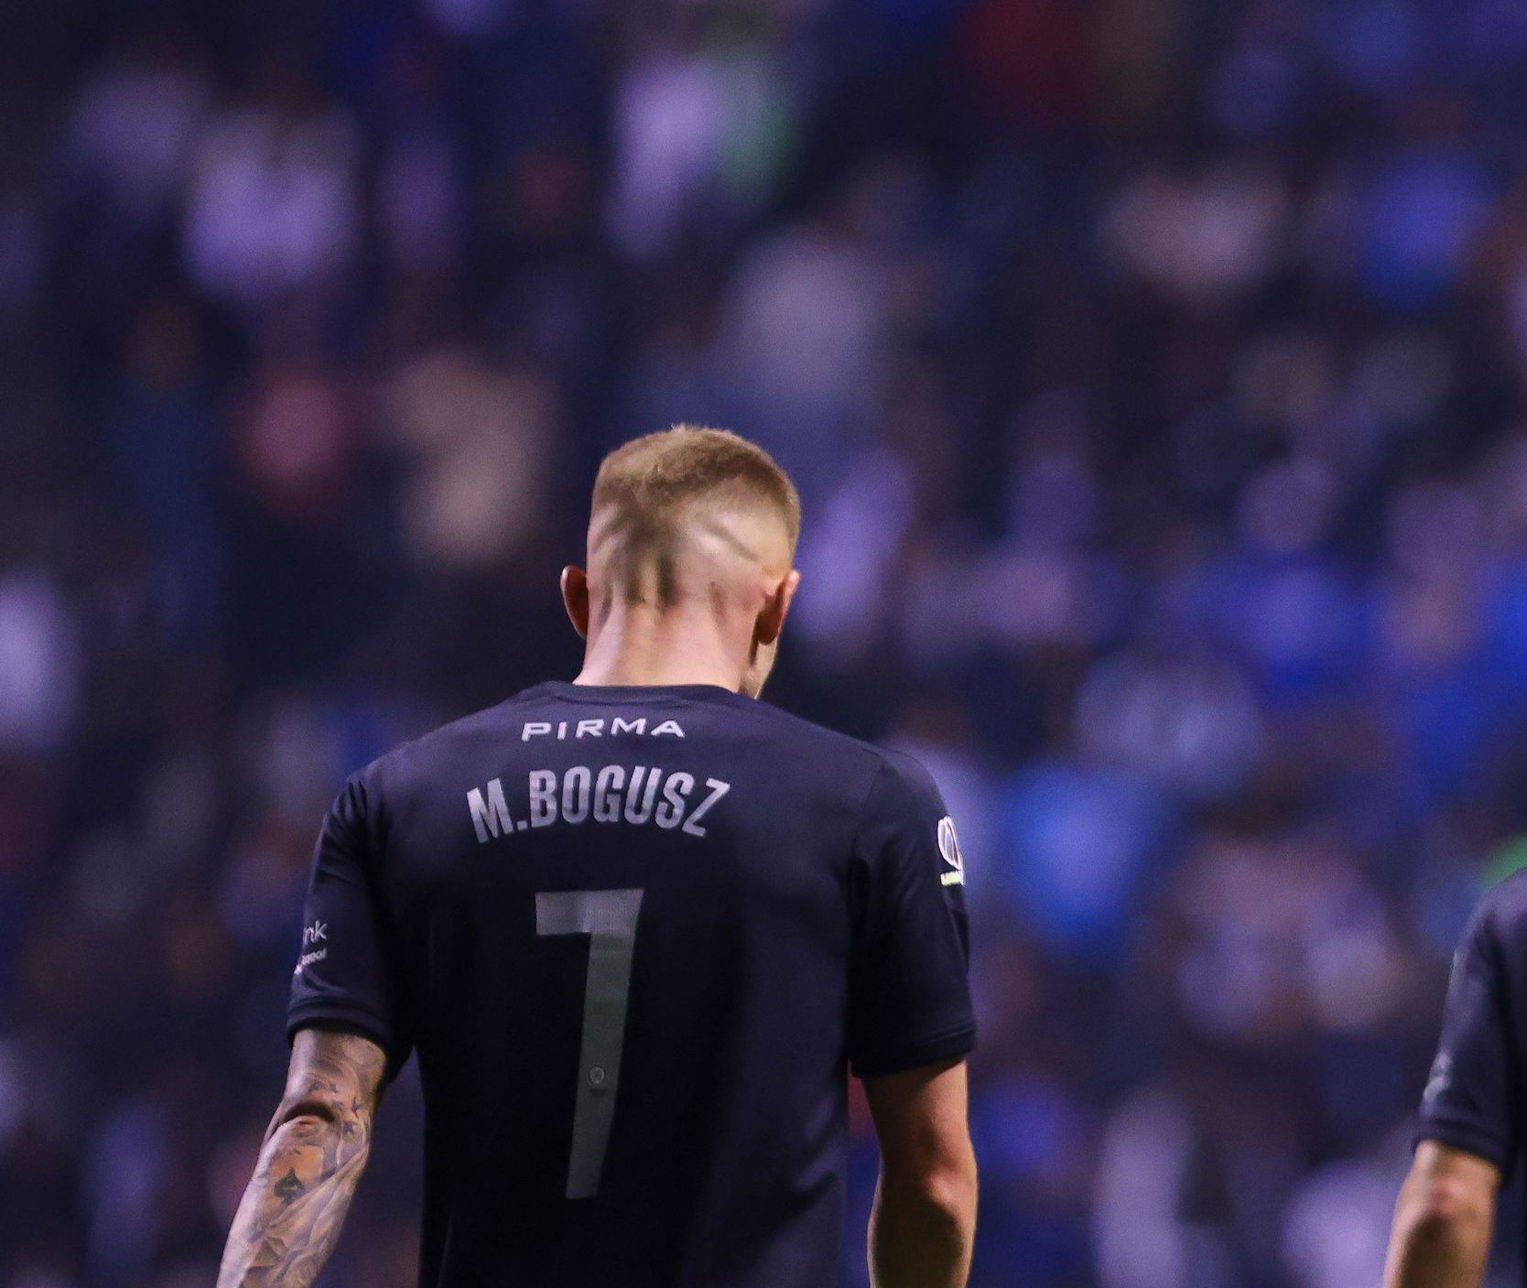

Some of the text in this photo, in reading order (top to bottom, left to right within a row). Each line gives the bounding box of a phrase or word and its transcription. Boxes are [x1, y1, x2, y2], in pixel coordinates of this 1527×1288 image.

[521, 717, 686, 741] PIRMA
[466, 764, 731, 844] M.BOGUSZ
[535, 888, 645, 1200] 7
